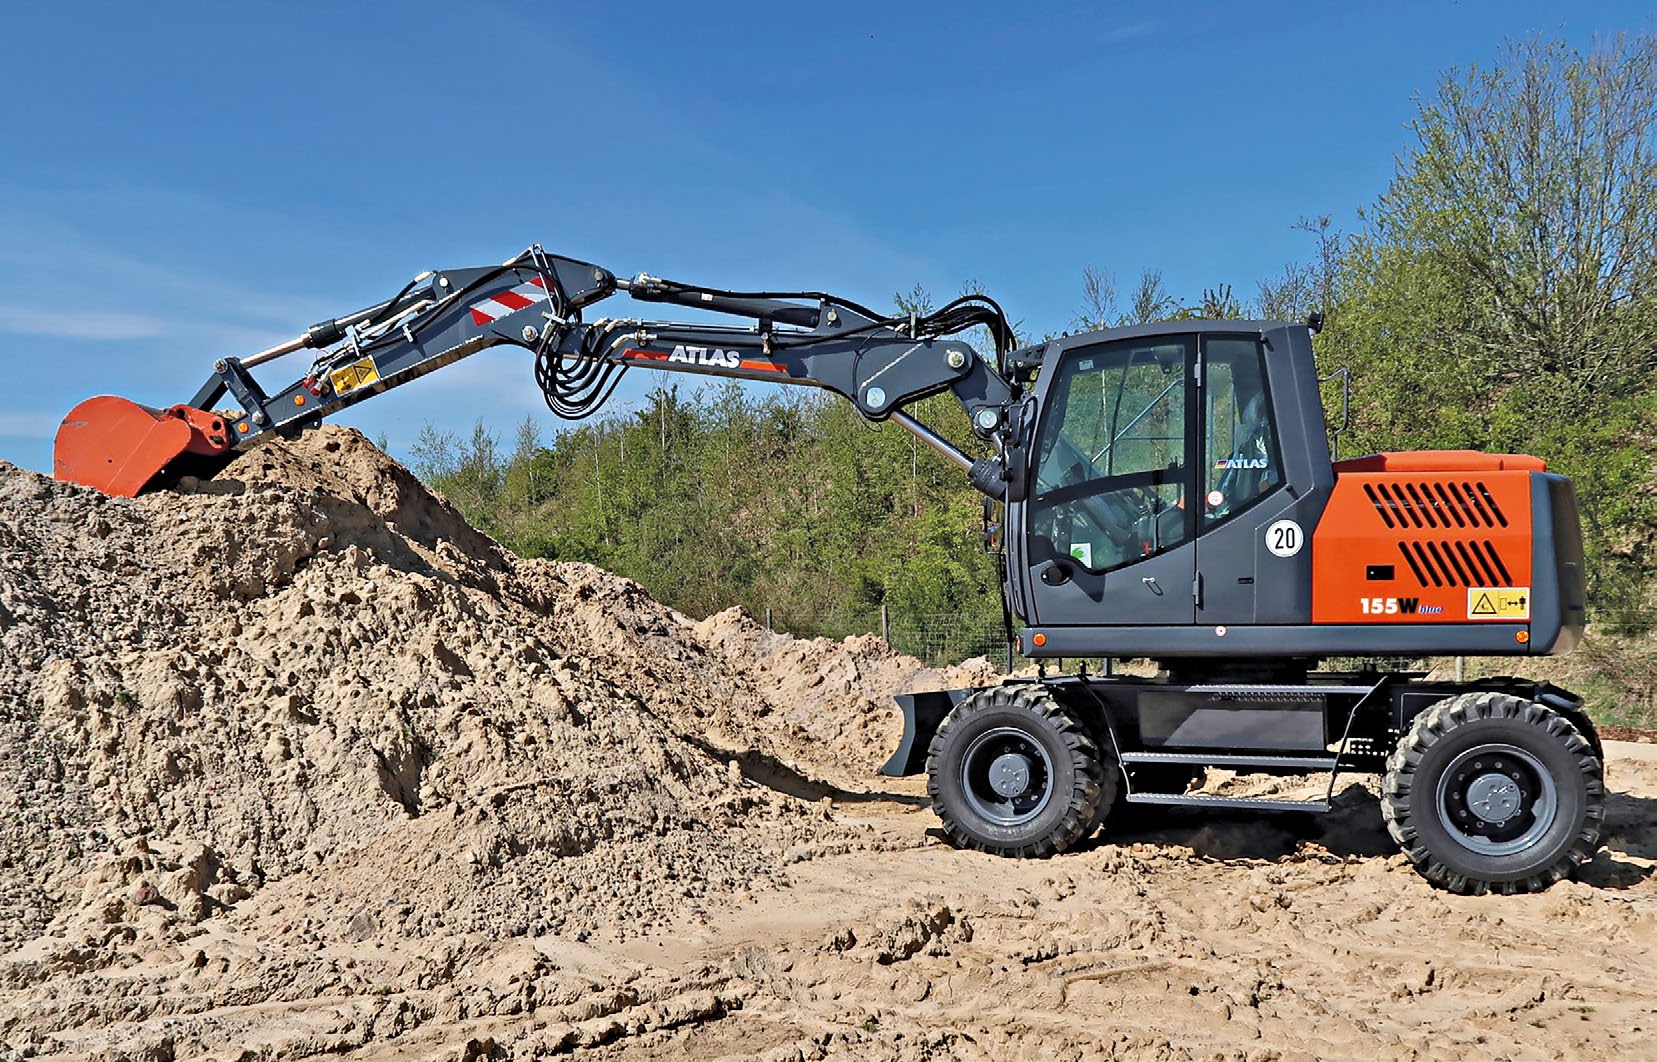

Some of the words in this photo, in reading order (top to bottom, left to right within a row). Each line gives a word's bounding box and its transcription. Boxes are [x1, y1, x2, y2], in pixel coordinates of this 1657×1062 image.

[668, 345, 740, 369] ATLAS
[1226, 459, 1267, 469] ATLAS
[1274, 527, 1296, 550] 20
